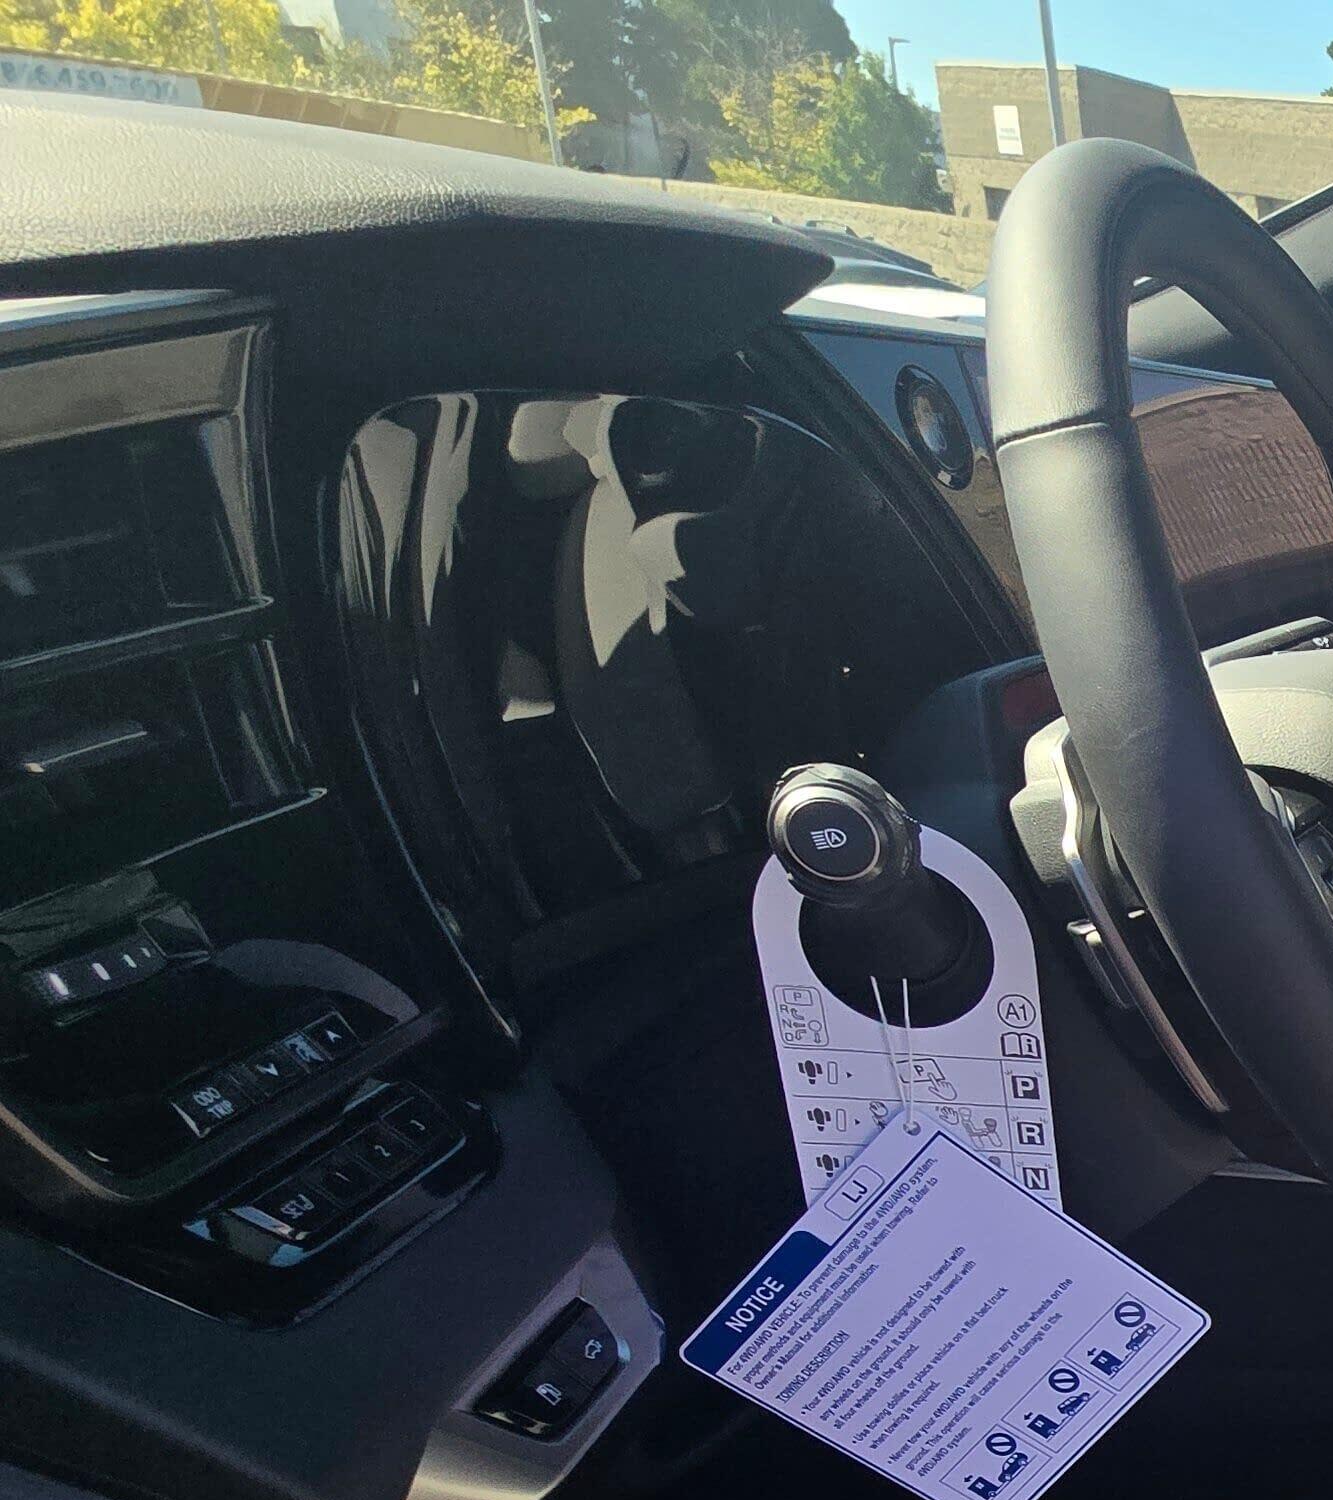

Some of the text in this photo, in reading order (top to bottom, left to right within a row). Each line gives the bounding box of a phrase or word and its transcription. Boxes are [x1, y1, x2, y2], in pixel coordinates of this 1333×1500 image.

[1005, 1002, 1027, 1022] A1
[1014, 1077, 1035, 1098] P
[1020, 1123, 1042, 1144] R
[841, 1179, 867, 1203] LJ
[1027, 1167, 1047, 1190] N
[725, 1276, 784, 1332] NOTICE
[726, 1157, 937, 1375] For 4WD/AWD VEHICLE: To prevent damage to the 4WD/AWD system,
[742, 1176, 938, 1384] proper methods and equipment must be used when towing. Refer to
[753, 1263, 879, 1389] Owner's Manual for additional information.
[801, 1246, 965, 1411] Your 4WD/AWD vehicle is not designed to be towed with
[819, 1260, 976, 1421] any wheels on the ground. It should only be towed with
[852, 1428, 870, 1441] Use
[865, 1408, 892, 1429] towing
[886, 1388, 910, 1409] dollies
[906, 1379, 917, 1389] or
[913, 1363, 933, 1383] place
[929, 1341, 955, 1364] vehicle
[952, 1332, 963, 1342] on
[963, 1315, 979, 1328] flat
[973, 1301, 992, 1317] bed
[987, 1287, 1008, 1305] truck
[775, 1330, 849, 1403] TOWING DESCRIPTION
[833, 1343, 919, 1429] all four wheels off the ground.
[888, 1278, 1072, 1461] Never tow your 4WD/AWD vehicle with any of the wheels on the
[904, 1312, 1063, 1471] ground. This operation will cause serious damage to the
[869, 1379, 940, 1449] when towing is required.
[917, 1427, 971, 1476] 4WD/AWD system.
